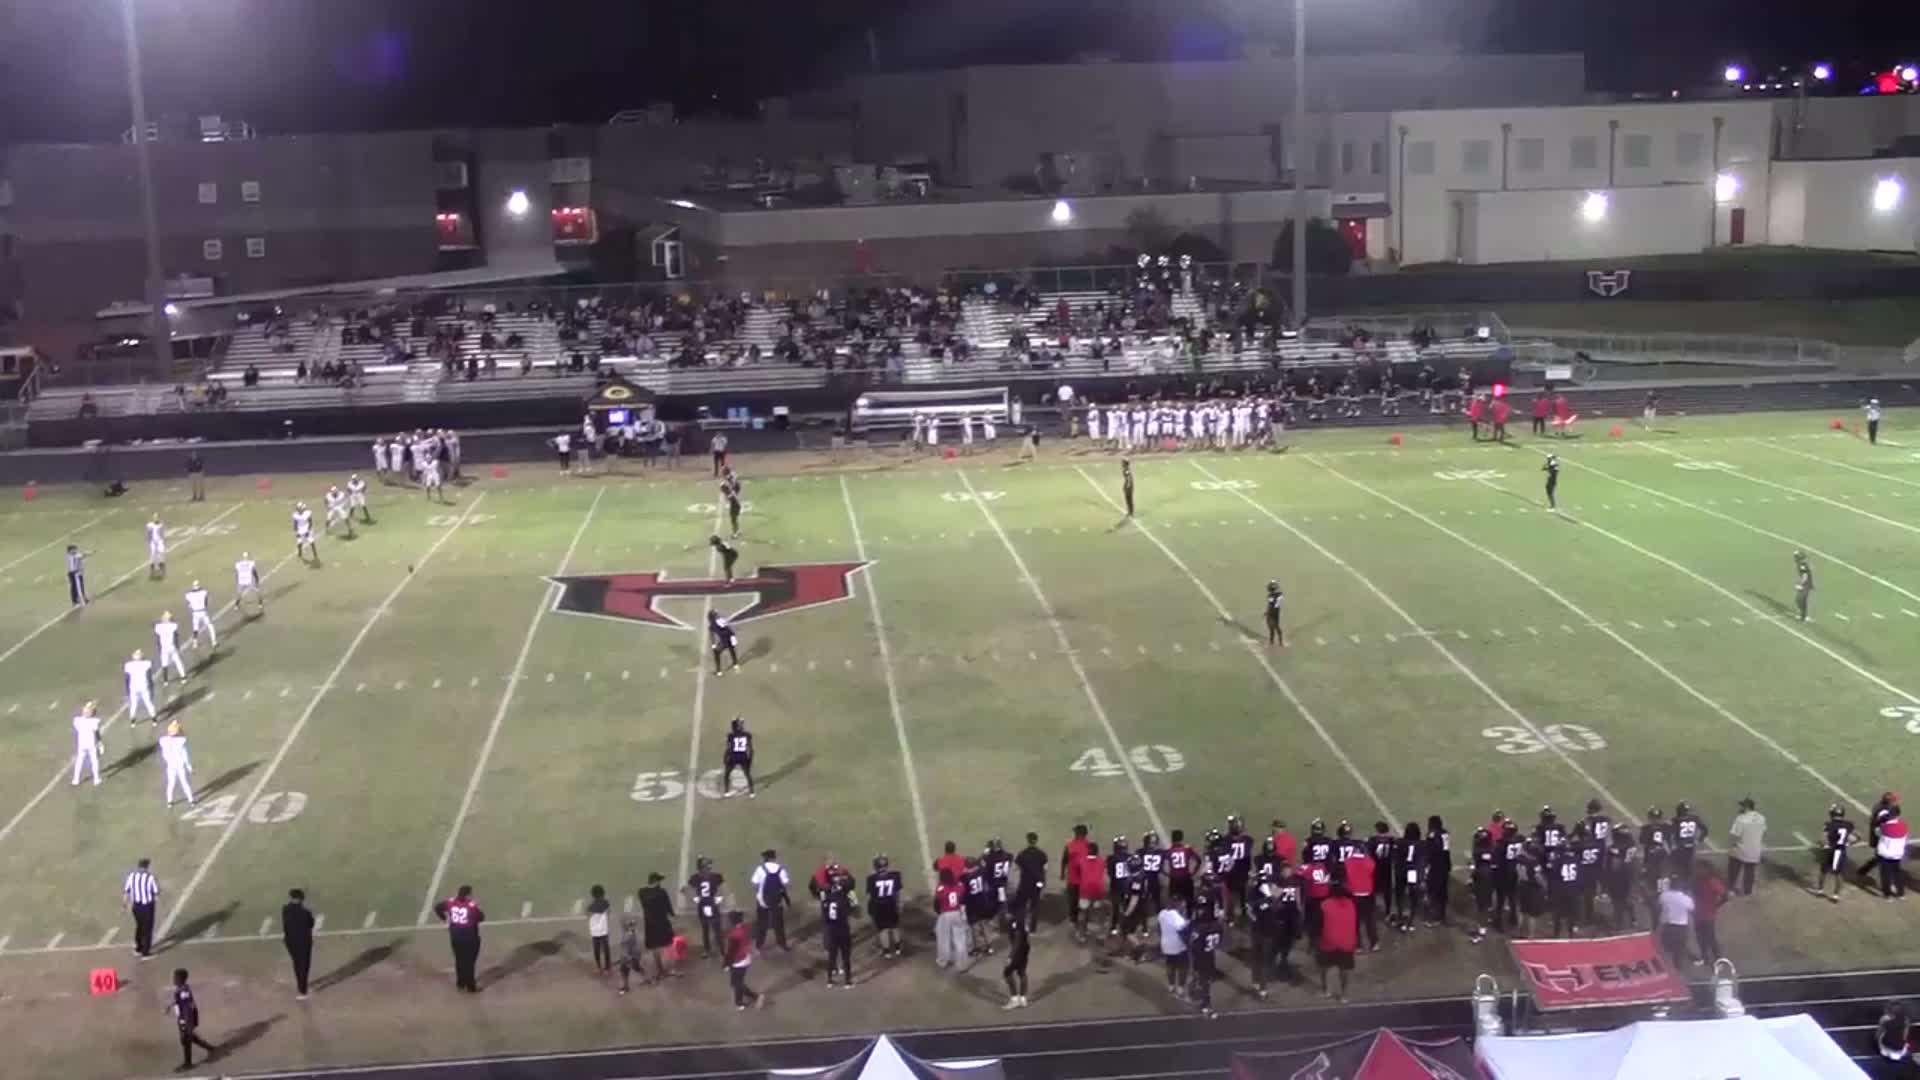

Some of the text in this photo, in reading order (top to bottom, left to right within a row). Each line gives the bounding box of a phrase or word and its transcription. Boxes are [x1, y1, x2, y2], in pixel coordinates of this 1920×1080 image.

[1482, 724, 1608, 754] 30
[1069, 744, 1185, 777] 40
[180, 791, 309, 827] 40
[1836, 828, 1848, 845] 7
[1171, 852, 1186, 869] 21
[1231, 843, 1246, 860] 71
[1143, 854, 1162, 872] 52
[700, 882, 711, 897] 2
[875, 880, 895, 898] 77
[968, 876, 985, 896] 31
[450, 906, 469, 924] 62
[94, 974, 114, 991] 40
